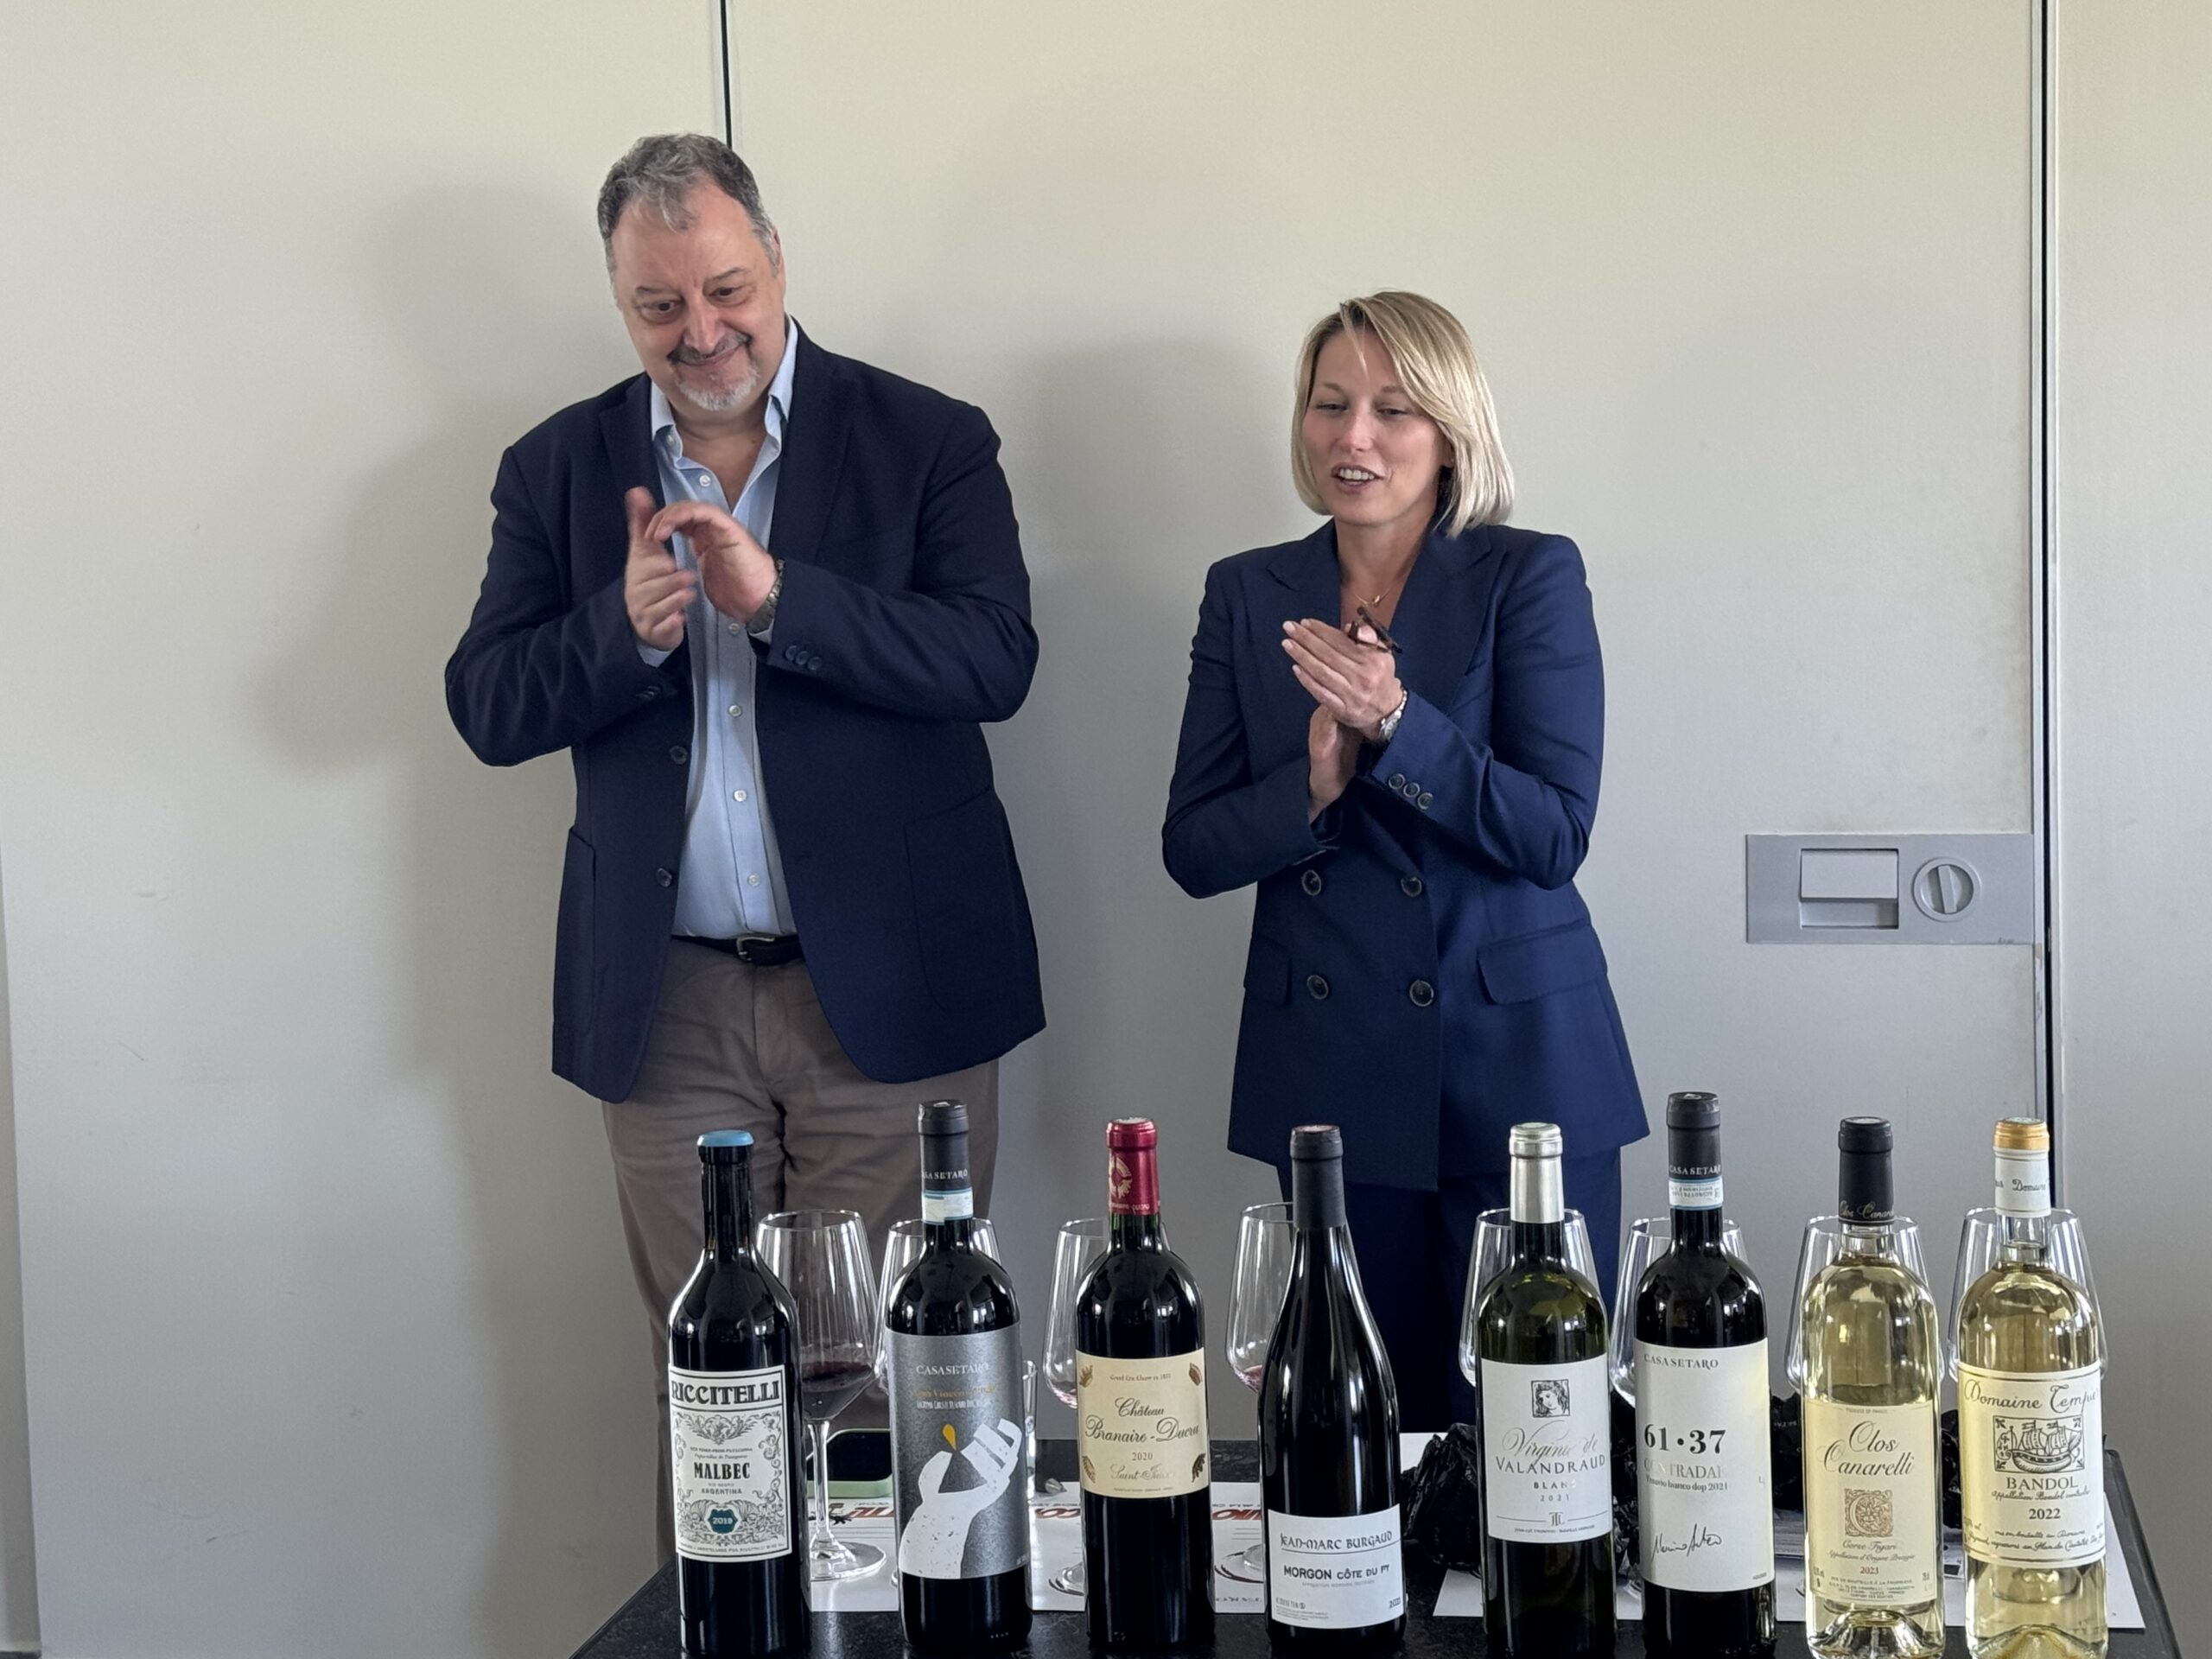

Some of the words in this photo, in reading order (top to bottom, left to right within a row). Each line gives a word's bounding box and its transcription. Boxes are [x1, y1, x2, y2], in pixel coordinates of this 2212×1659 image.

[671, 1380, 780, 1405] RICCITELLI
[1964, 1378, 2042, 1409] Domaine
[1114, 1396, 1165, 1418] Château
[1848, 1420, 1900, 1453] Clos
[1131, 1451, 1154, 1462] 2020
[1495, 1453, 1606, 1475] VALANDRAUD
[1815, 1438, 1916, 1477] Canarelli
[693, 1461, 751, 1480] MALBEC
[701, 1487, 743, 1496] ARGENTINA
[2005, 1476, 2079, 1491] BANDOL
[1540, 1494, 1570, 1503] 2021
[2028, 1508, 2062, 1520] 2022
[1280, 1532, 1343, 1551] JEAN-MARC
[1346, 1529, 1393, 1549] BURGAUD
[1283, 1564, 1332, 1580] MORGON
[1336, 1567, 1363, 1580] CÔTE
[1366, 1567, 1378, 1577] DU
